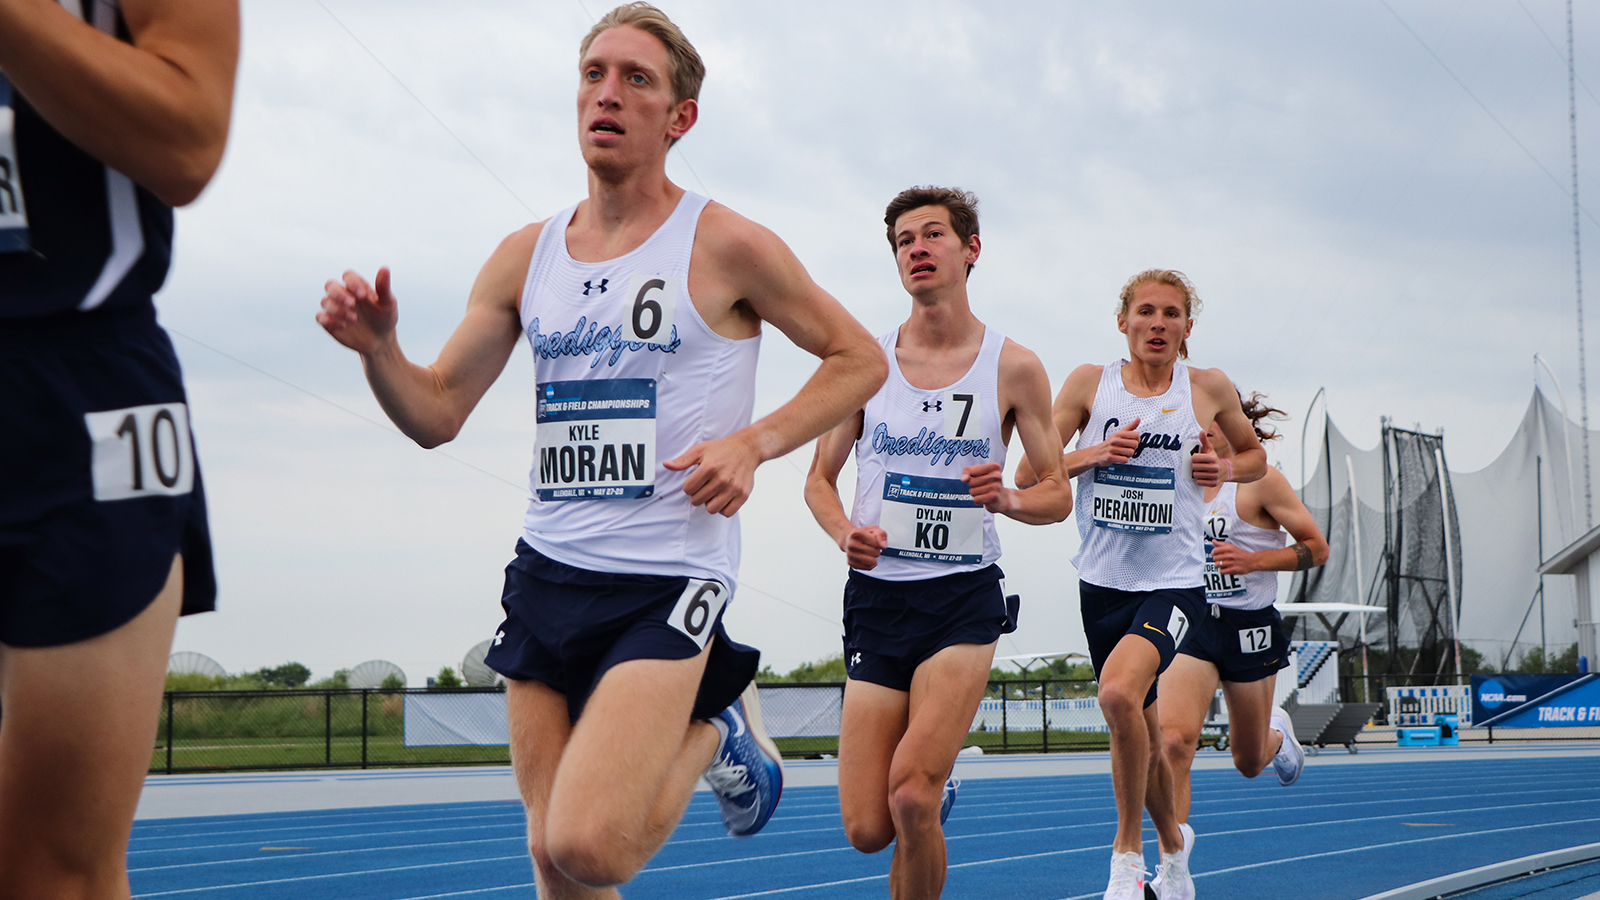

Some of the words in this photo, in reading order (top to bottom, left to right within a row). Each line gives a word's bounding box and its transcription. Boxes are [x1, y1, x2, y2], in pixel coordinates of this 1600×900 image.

[632, 278, 666, 340] 6
[546, 402, 562, 412] TRACK
[568, 400, 587, 411] FIELD
[587, 399, 650, 410] CHAMPIONSHIPS
[952, 394, 974, 438] 7
[569, 424, 599, 441] KYLE
[872, 422, 991, 466] Orediggers
[116, 409, 180, 491] 10
[540, 443, 645, 484] MORAN
[1123, 475, 1136, 483] FIELD
[900, 488, 917, 498] TRACK
[922, 491, 938, 500] FIELD
[1120, 489, 1144, 500] JOSH
[916, 508, 952, 522] DYLAN
[1094, 496, 1173, 524] PIERANTONI
[915, 522, 949, 551] KO
[1208, 517, 1229, 538] 12
[684, 582, 721, 636] 6
[1246, 628, 1268, 651] 12
[1538, 706, 1576, 721] TRACK
[1576, 706, 1587, 721] &
